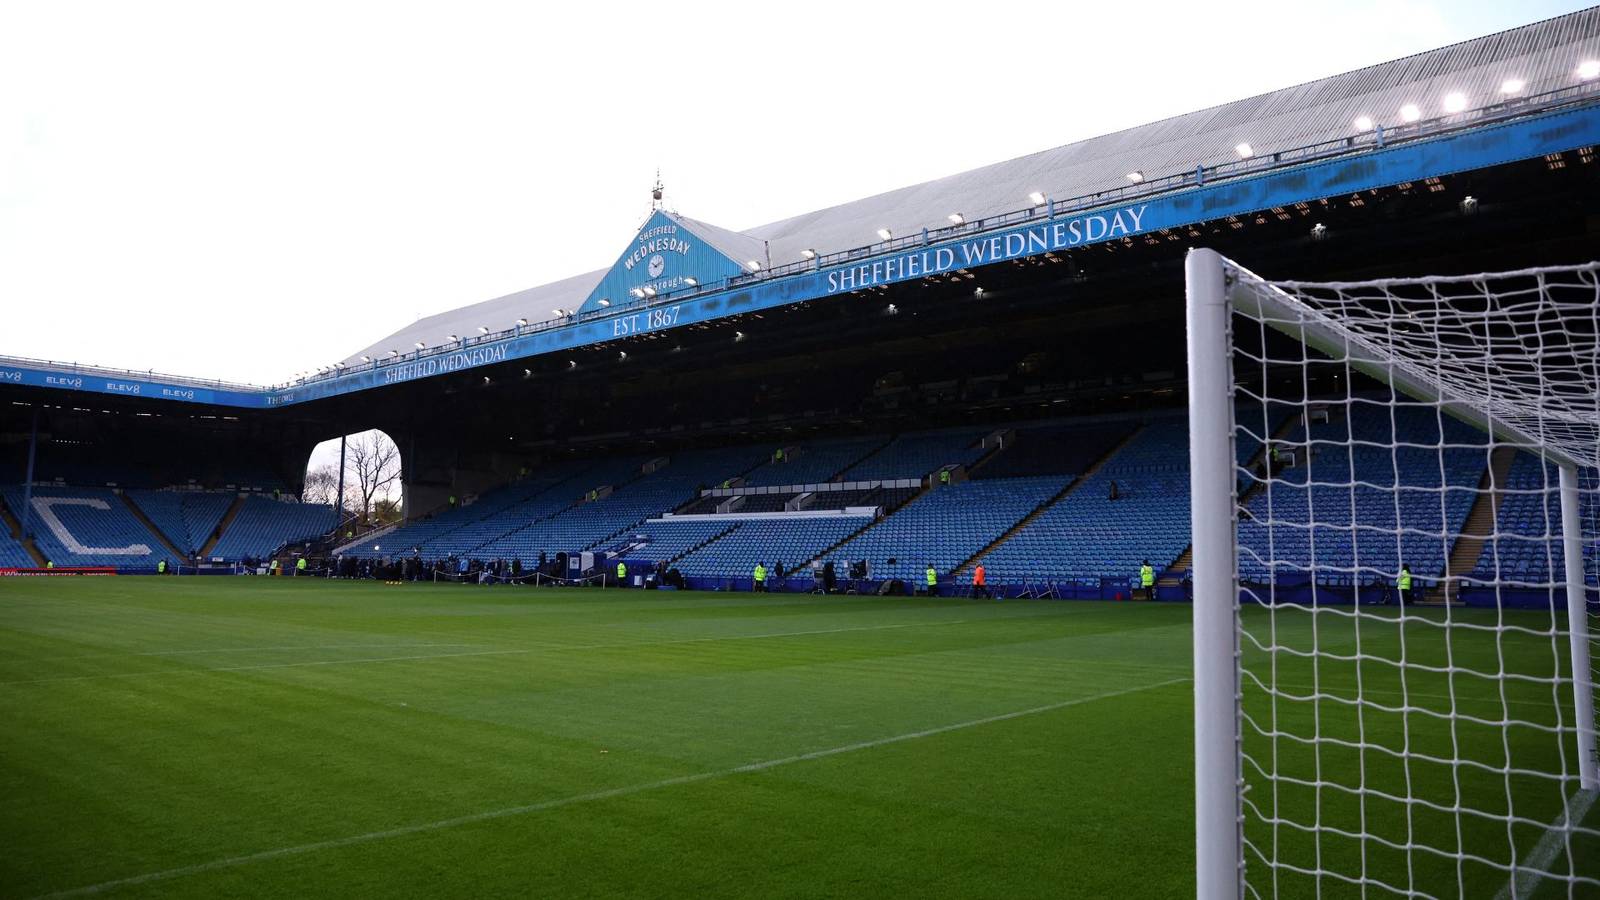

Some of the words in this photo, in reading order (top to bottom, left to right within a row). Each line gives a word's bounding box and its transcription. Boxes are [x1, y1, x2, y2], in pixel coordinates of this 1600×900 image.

[639, 225, 677, 243] SHEFFIELD
[624, 238, 691, 271] WEDNESDAY
[828, 247, 955, 293] SHEFFIELD
[961, 205, 1148, 266] WEDNESDAY
[613, 314, 641, 336] EST.
[647, 305, 681, 330] 1867
[385, 360, 437, 384] SHEFFIELD
[439, 343, 509, 372] WEDNESDAY
[46, 376, 82, 388] ELEV8
[106, 383, 140, 394] ELEV8
[162, 388, 194, 400] ELEV8
